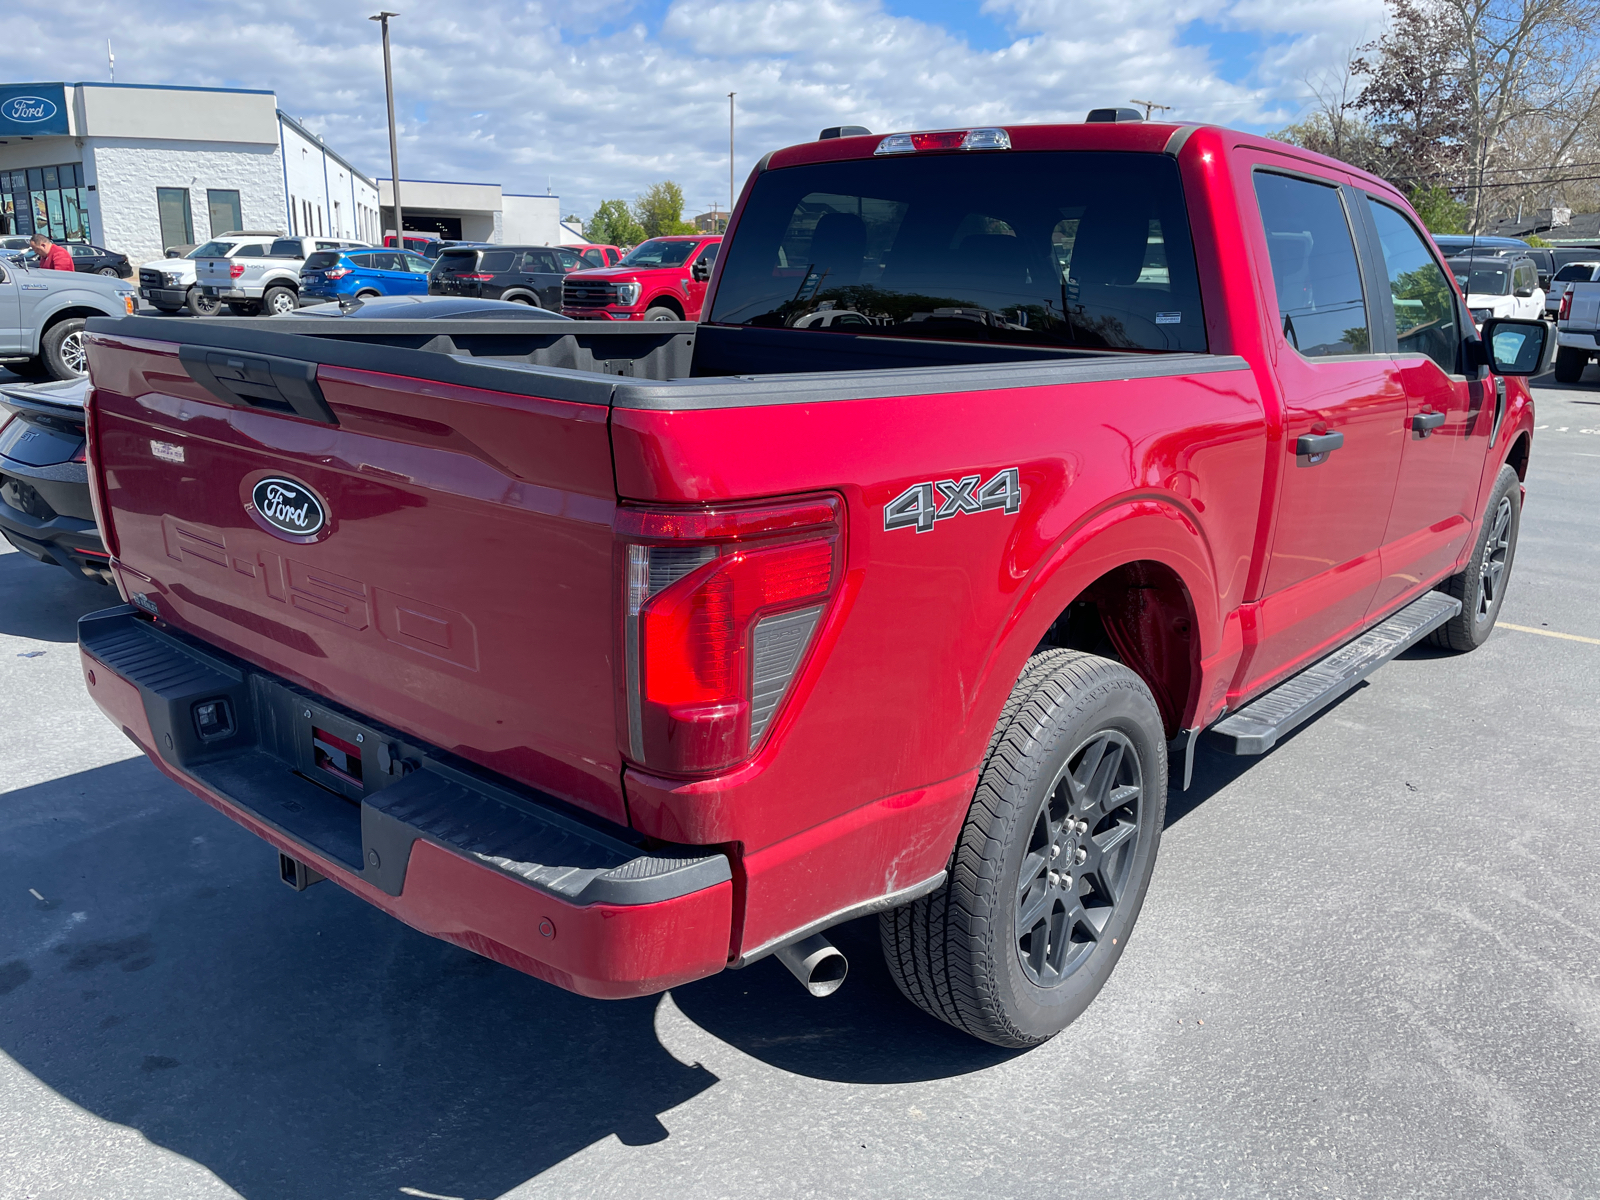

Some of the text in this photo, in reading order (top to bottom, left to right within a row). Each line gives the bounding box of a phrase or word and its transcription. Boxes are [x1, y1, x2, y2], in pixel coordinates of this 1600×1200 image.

[12, 99, 45, 118] Ford
[264, 484, 308, 527] Ford
[161, 513, 479, 672] F-150
